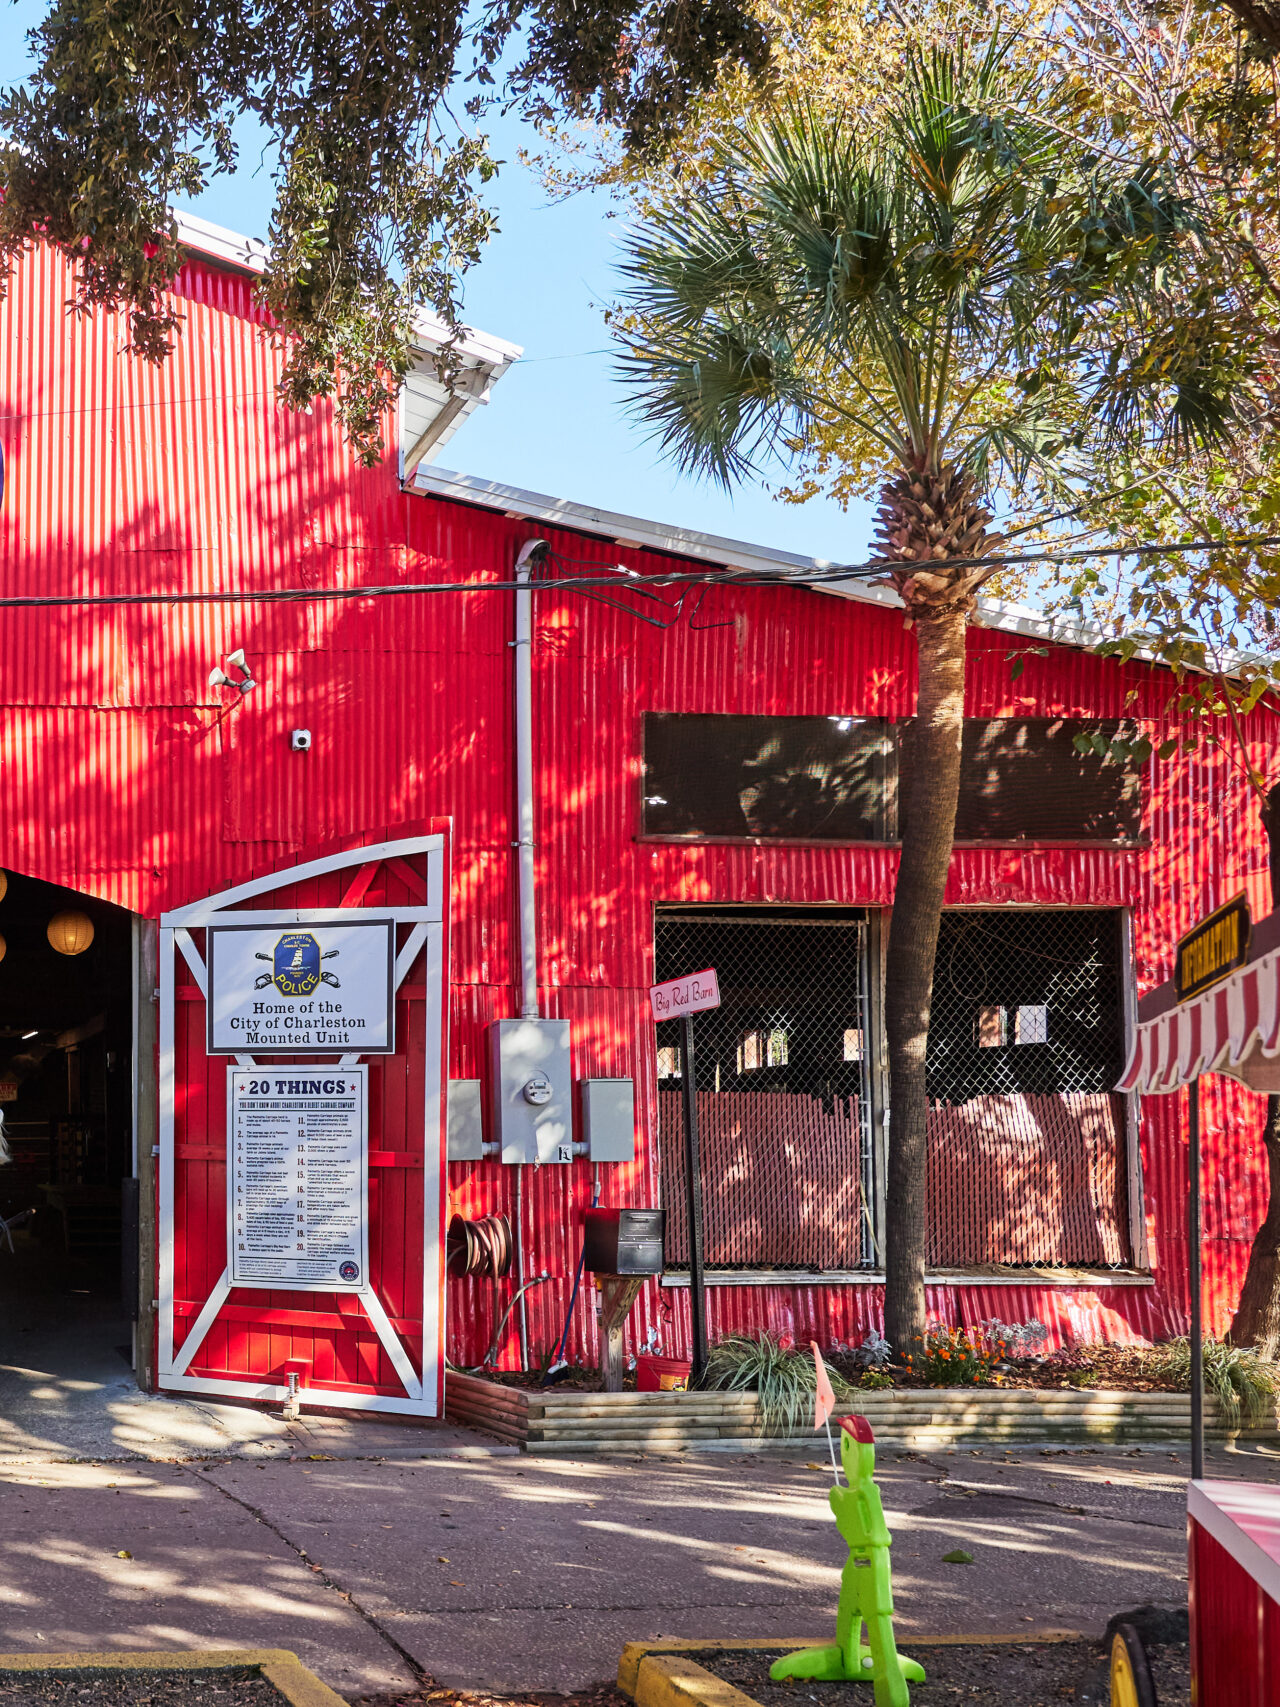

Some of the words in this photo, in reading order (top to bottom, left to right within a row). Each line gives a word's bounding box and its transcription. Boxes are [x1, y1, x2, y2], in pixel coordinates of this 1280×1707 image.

[276, 972, 318, 994] POLICE
[654, 992, 670, 1014] Big
[672, 984, 689, 1006] Red
[692, 981, 713, 1001] Barn
[252, 1002, 295, 1014] Home
[300, 1002, 314, 1013] of
[318, 1001, 342, 1013] the
[230, 1017, 261, 1031] City
[265, 1017, 280, 1028] of
[284, 1016, 366, 1028] Charleston
[246, 1032, 310, 1044] Mounted
[316, 1031, 350, 1043] Unit
[249, 1080, 270, 1094] 20
[275, 1080, 345, 1094] THINGS
